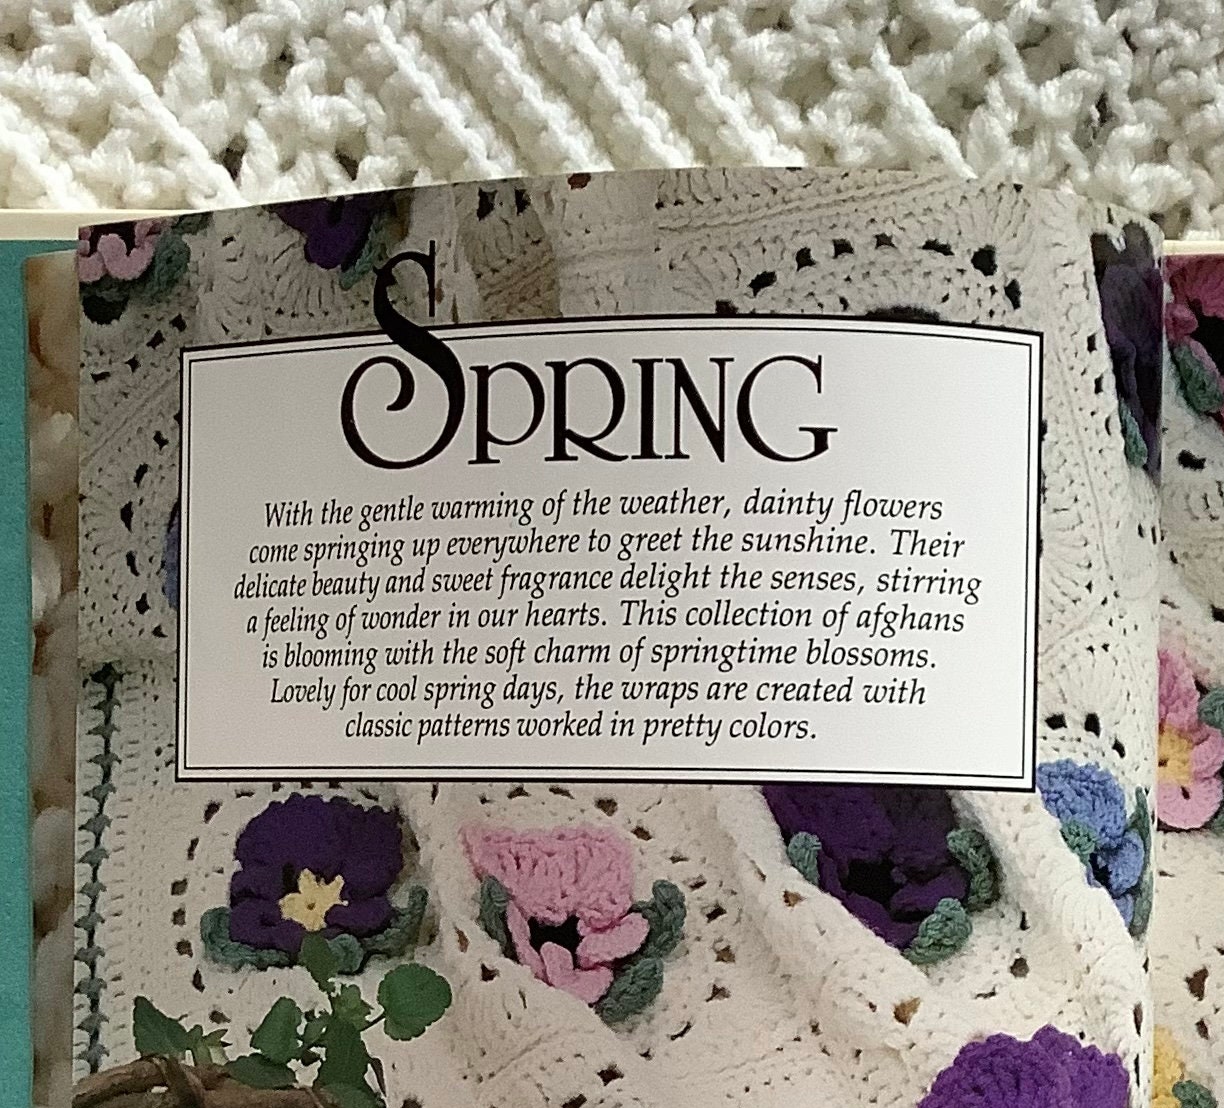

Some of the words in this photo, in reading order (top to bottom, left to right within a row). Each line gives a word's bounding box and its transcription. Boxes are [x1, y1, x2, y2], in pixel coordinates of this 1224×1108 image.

[340, 240, 838, 470] SPRING
[264, 499, 313, 528] With
[320, 498, 354, 525] the
[358, 494, 425, 533] gentle
[431, 490, 535, 527] warming
[542, 488, 568, 526] of
[572, 488, 612, 516] the
[619, 486, 731, 520] weather,
[743, 486, 835, 525] dainty
[839, 489, 943, 526] flowers
[249, 543, 299, 564] come
[303, 531, 406, 570] springing
[412, 537, 441, 566] up
[446, 526, 581, 564] everywhere
[587, 528, 612, 553] to
[616, 526, 683, 562] greet
[691, 524, 734, 552] the
[741, 525, 876, 555] sunshine.
[890, 528, 966, 558] Their
[233, 572, 307, 600] delicate
[311, 570, 381, 604] beauty
[385, 565, 426, 594] and
[431, 567, 494, 593] sweet
[497, 563, 614, 600] fragrance
[619, 561, 712, 599] delight
[719, 561, 763, 590] the
[770, 570, 865, 596] senses,
[876, 566, 983, 606] stirring
[246, 615, 258, 634] a
[261, 605, 330, 642] feeling
[335, 603, 358, 640] of
[361, 602, 442, 631] wonder
[448, 601, 470, 629] in
[477, 608, 519, 628] our
[524, 599, 607, 627] hearts.
[619, 598, 677, 627] This
[685, 598, 812, 628] collection
[822, 600, 852, 638] of
[855, 601, 965, 639] afghans
[262, 642, 278, 669] is
[284, 640, 379, 675] blooming
[384, 638, 434, 666] with
[442, 637, 478, 665] the
[484, 636, 527, 674] soft
[533, 636, 611, 664] charm
[619, 635, 647, 673] of
[650, 636, 798, 673] springtime
[805, 637, 936, 669] blossoms.
[270, 676, 337, 712] Lovely
[339, 675, 373, 711] for
[376, 674, 418, 702] cool
[423, 674, 497, 710] spring
[502, 673, 564, 710] days,
[575, 672, 614, 701] the
[620, 681, 699, 710] wraps
[706, 681, 749, 701] are
[756, 675, 854, 703] created
[862, 677, 926, 705] with
[345, 711, 413, 738] classic
[416, 712, 511, 746] patterns
[516, 709, 604, 737] worked
[610, 710, 635, 737] in
[641, 713, 723, 747] pretty
[729, 711, 817, 740] colors.
